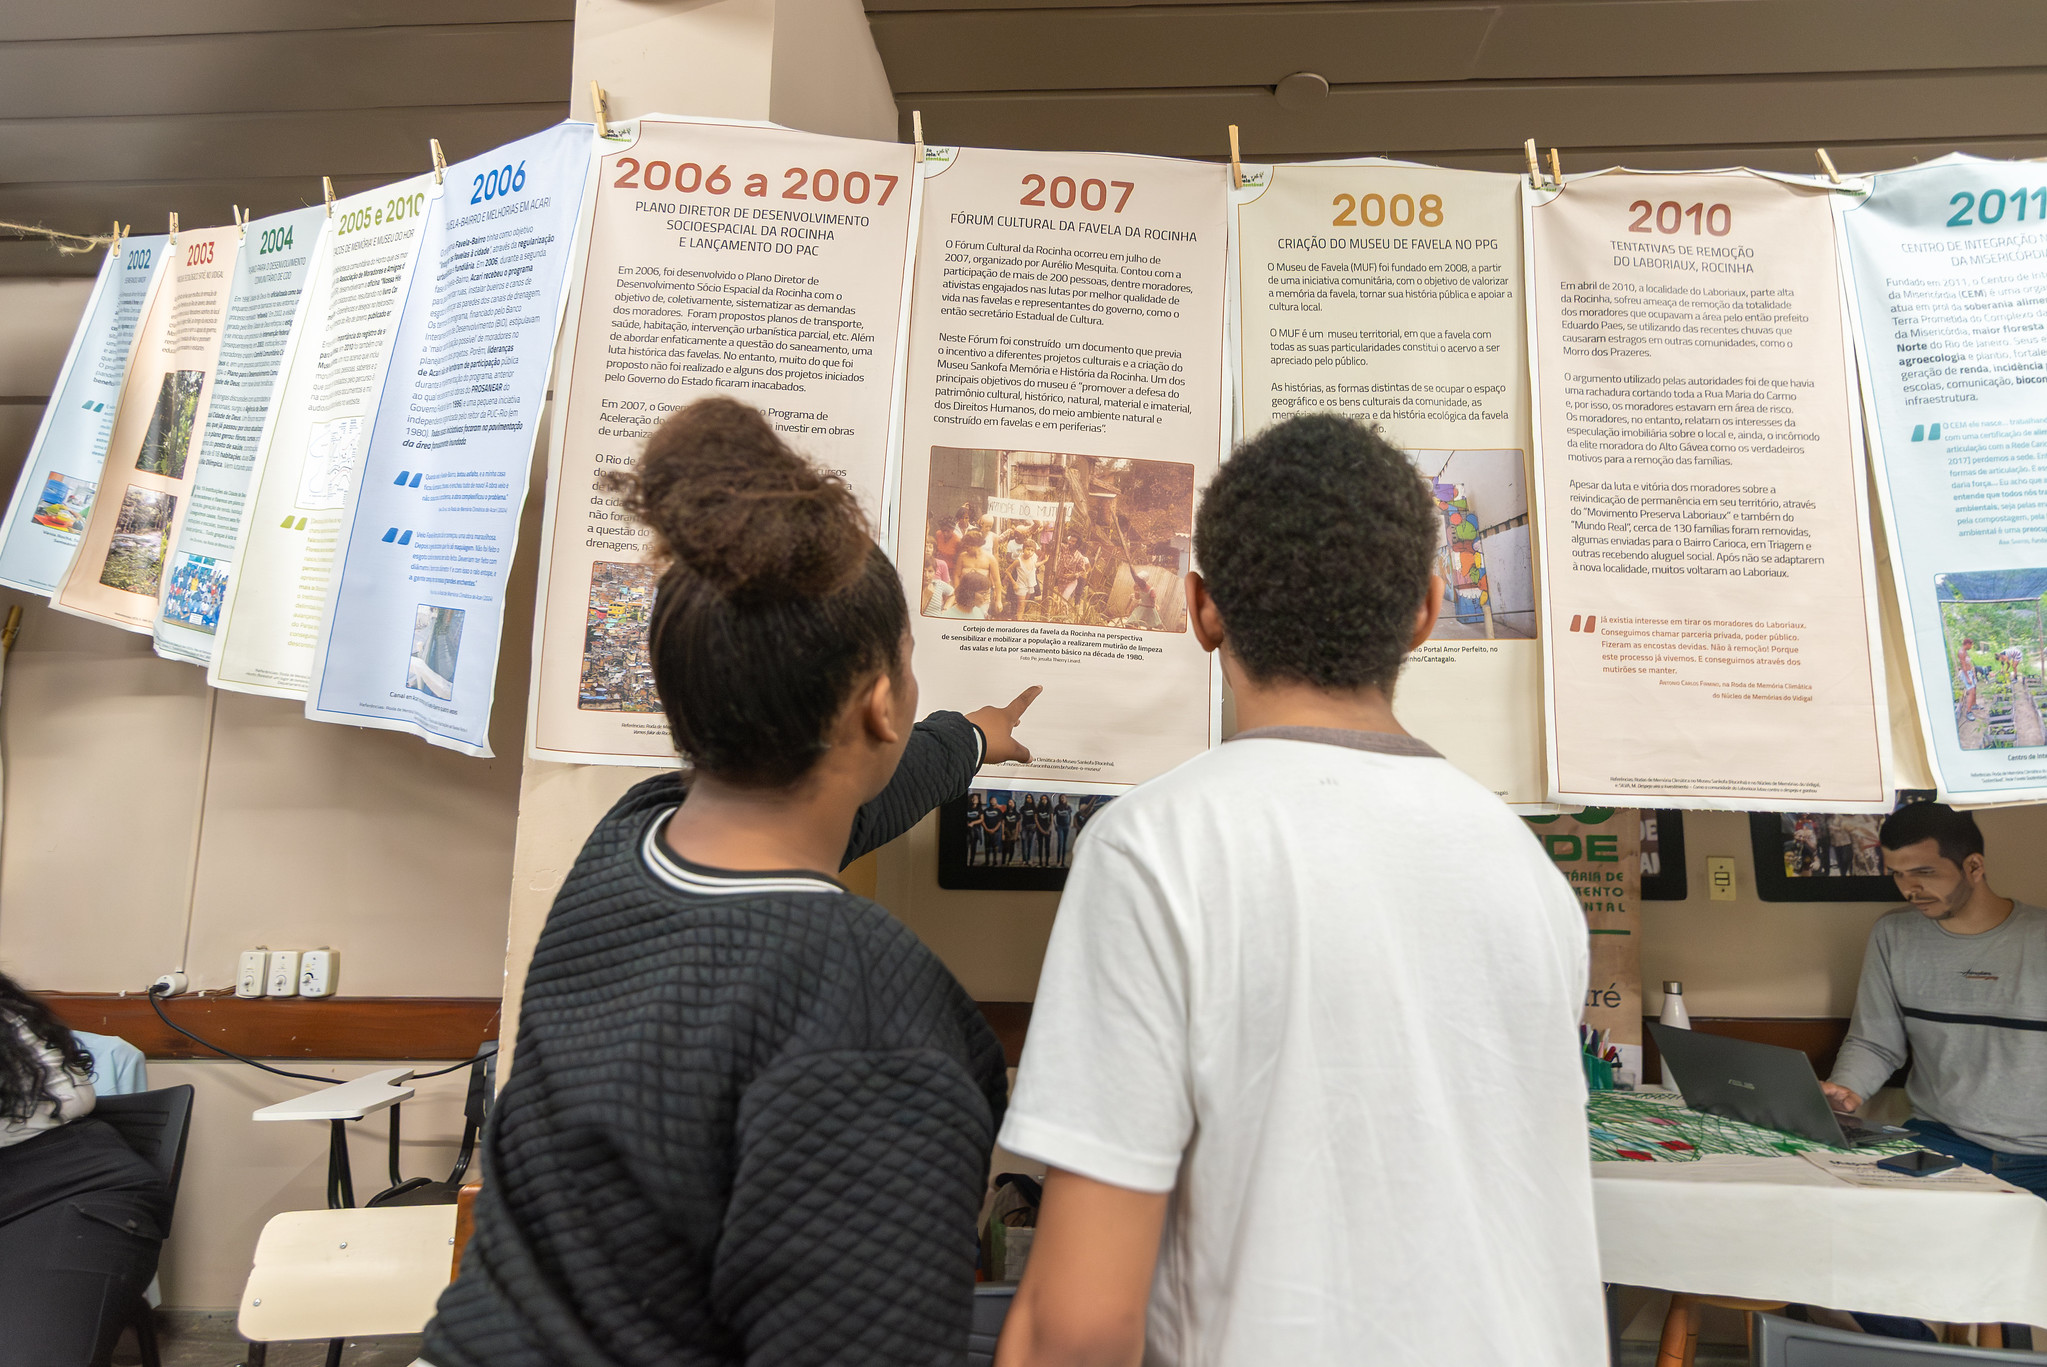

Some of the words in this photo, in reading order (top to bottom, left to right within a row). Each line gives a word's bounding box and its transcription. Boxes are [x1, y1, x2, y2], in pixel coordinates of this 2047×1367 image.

[470, 160, 526, 205] 2006
[614, 158, 731, 194] 2006
[744, 173, 768, 197] a
[782, 168, 898, 205] 2007
[1020, 174, 1134, 213] 2007
[338, 206, 372, 236] 2005
[375, 208, 382, 225] e
[386, 193, 424, 223] 2010
[482, 212, 486, 222] E
[487, 203, 519, 220] MELHORIAS
[520, 201, 529, 213] EM
[530, 197, 551, 210] ACARI
[636, 201, 676, 214] PLANO
[679, 204, 730, 217] DIRETOR
[734, 208, 749, 218] DE
[753, 209, 869, 226] DESENVOLVIMENTO
[1332, 193, 1443, 227] 2008
[1946, 186, 2047, 226] 2011
[951, 211, 993, 225] FÓRUM
[997, 216, 1056, 230] CULTURAL
[1059, 220, 1075, 231] DA
[1079, 222, 1121, 235] FAVELA
[1125, 226, 1141, 237] DA
[1144, 228, 1197, 242] ROCINHA
[1628, 200, 1731, 235] 2010
[260, 224, 293, 255] 2004
[455, 237, 486, 249] Favela-Bairro
[499, 231, 513, 240] como
[513, 225, 534, 239] objetivo
[667, 220, 757, 235] SOCIOESPACIAL
[761, 225, 777, 236] DA
[781, 227, 834, 240] ROCINHA
[517, 234, 555, 249] regularização
[679, 237, 686, 247] E
[690, 238, 772, 252] LANÇAMENTO
[775, 243, 793, 254] DO
[796, 244, 819, 256] PAC
[1278, 235, 1326, 251] CRIAÇÃO
[1330, 238, 1346, 249] DO
[1350, 238, 1390, 249] MUSEU
[1394, 238, 1408, 249] DE
[1412, 239, 1452, 250] FAVELA
[1455, 239, 1472, 250] NO
[1475, 239, 1498, 250] PPG
[1610, 241, 1675, 254] TENTATIVAS
[1678, 245, 1693, 256] DE
[1696, 246, 1754, 260] REMOÇÃO
[1901, 242, 1944, 253] CENTRO
[1947, 240, 1962, 251] DE
[1964, 233, 2037, 249] INTEGRAÇÃO
[127, 248, 150, 270] 2002
[187, 241, 215, 266] 2003
[946, 240, 953, 249] O
[955, 240, 984, 250] Fórum
[987, 242, 1021, 252] Cultural
[1023, 244, 1034, 253] da
[1036, 245, 1072, 256] Rocinha
[1074, 250, 1108, 259] ocorreu
[1110, 253, 1124, 261] em
[1125, 253, 1148, 264] julho
[1150, 256, 1161, 264] de
[1951, 256, 1968, 267] DA
[1969, 246, 2047, 264] MISERICÓRDI
[470, 270, 484, 281] Acari
[484, 268, 504, 279] recebeu
[508, 265, 533, 277] programa
[1267, 262, 1274, 271] O
[1277, 263, 1306, 272] Museu
[1308, 263, 1319, 272] de
[1321, 263, 1349, 272] Favela
[1351, 262, 1377, 273] (MUF)
[1379, 262, 1389, 272] foi
[1391, 263, 1427, 272] fundado
[1445, 264, 1470, 273] 2008,
[1479, 264, 1501, 274] partir
[1614, 256, 1630, 267] DO
[1633, 259, 1698, 272] LABORIAUX,
[1702, 262, 1754, 273] ROCINHA
[618, 266, 633, 274] Em
[635, 266, 661, 277] 2006,
[664, 267, 675, 276] foi
[676, 268, 736, 280] desenvolvido
[738, 273, 744, 281] o
[746, 272, 772, 282] Plano
[774, 274, 806, 284] Diretor
[807, 276, 819, 286] de
[1885, 278, 1925, 287] Fundado
[1942, 278, 1971, 287] 2011,
[1981, 276, 2015, 285] Centro
[2016, 273, 2029, 281] de
[1561, 281, 1576, 290] Em
[1577, 281, 1597, 290] abril
[1599, 281, 1610, 291] de
[1612, 282, 1637, 293] 2010,
[1646, 284, 1688, 294] localidade
[1690, 287, 1701, 295] do
[1703, 288, 1748, 297] Laboriaux,
[1750, 289, 1775, 298] parte
[1777, 288, 1794, 297] alta
[471, 382, 503, 393] PROSANEAR
[1905, 393, 1978, 406] infraestrutura.
[1609, 616, 1633, 624] existia
[1635, 617, 1669, 625] interesse
[1684, 618, 1701, 626] tirar
[1713, 620, 1753, 628] moradores
[1766, 621, 1806, 629] Laboriaux.
[963, 625, 985, 633] Cortejo
[1107, 634, 1143, 642] perspectiva
[1601, 628, 1651, 638] Conseguimos
[1681, 631, 1713, 639] parceria
[1713, 632, 1743, 640] privada,
[1745, 633, 1768, 641] poder
[1769, 633, 1799, 642] público.
[1541, 834, 1618, 862] DE
[1606, 872, 1623, 882] DE
[1585, 982, 1621, 1008] ré
